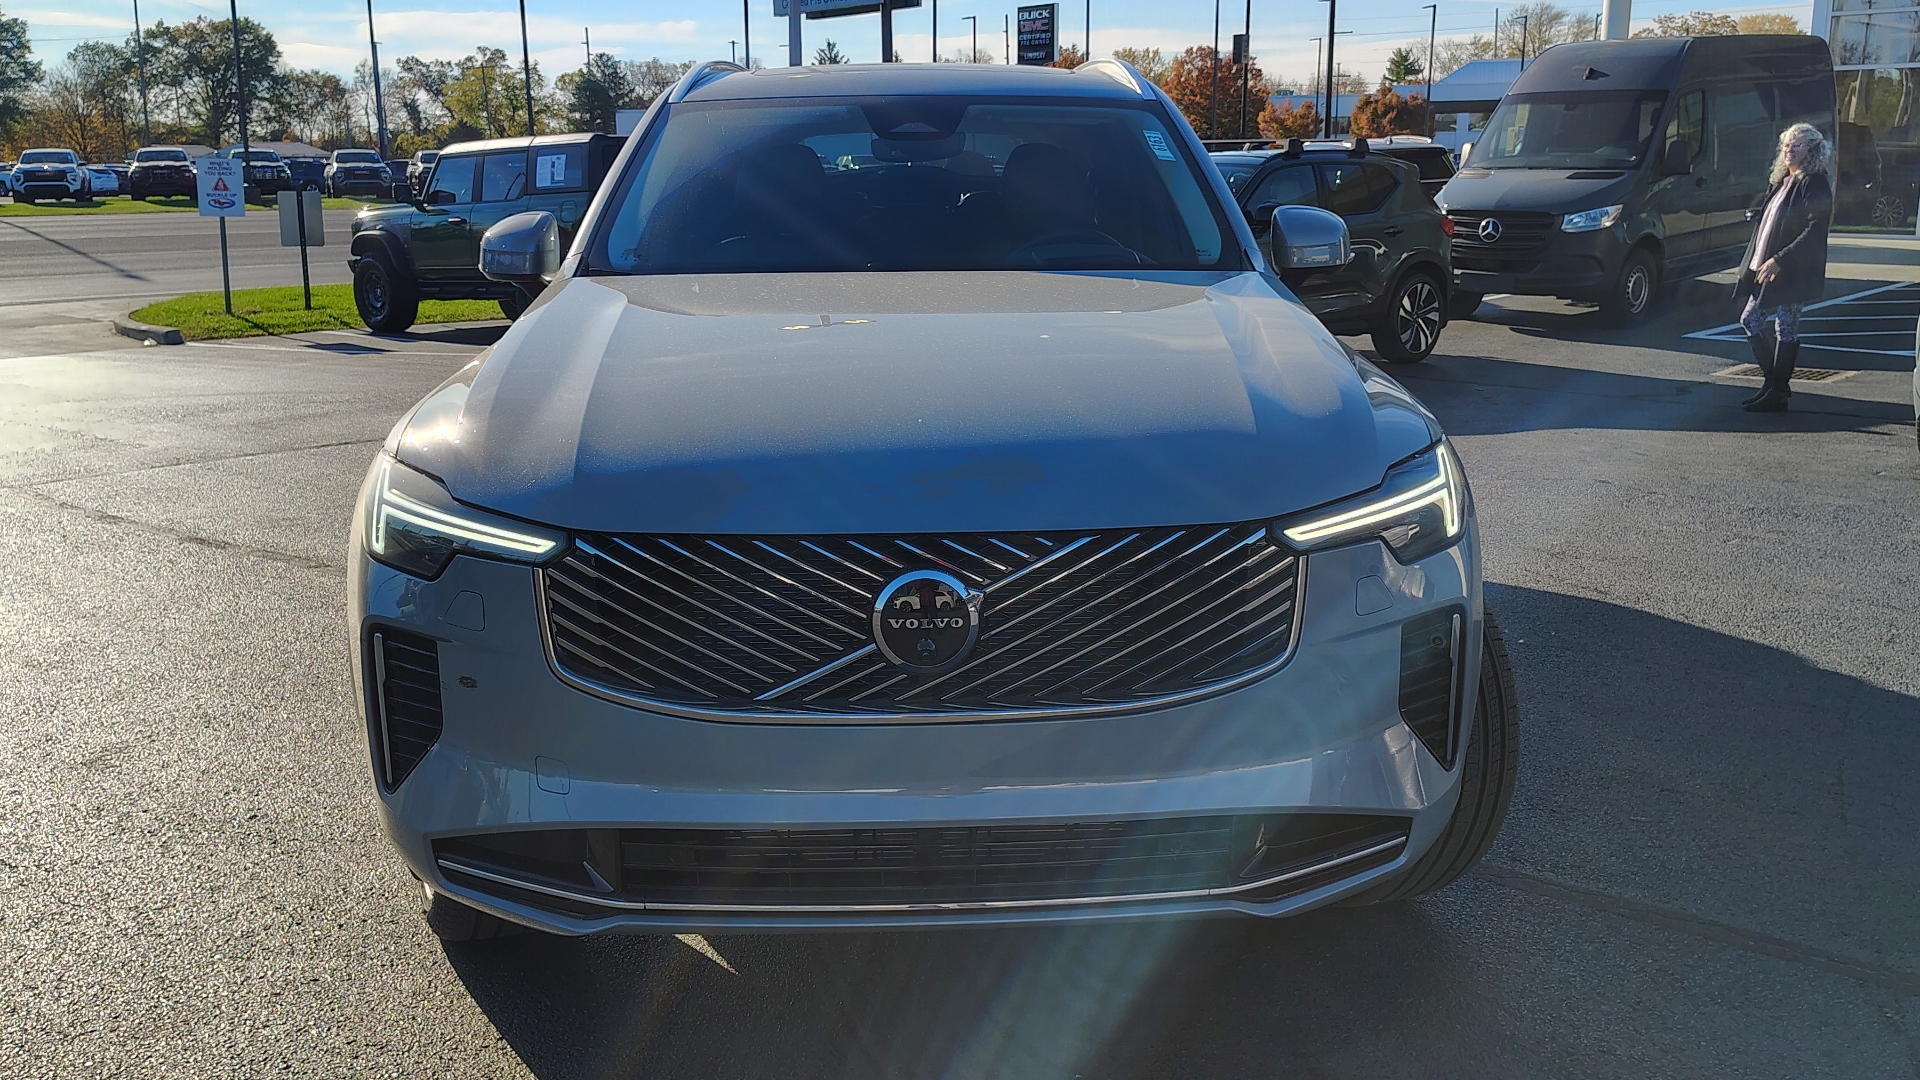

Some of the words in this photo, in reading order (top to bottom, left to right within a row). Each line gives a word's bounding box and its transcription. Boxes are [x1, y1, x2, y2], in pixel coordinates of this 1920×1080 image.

[1019, 9, 1050, 20] BUICK
[1020, 19, 1049, 32] GMC
[1019, 32, 1051, 40] CERTIFIED
[887, 618, 964, 629] VOLVO
